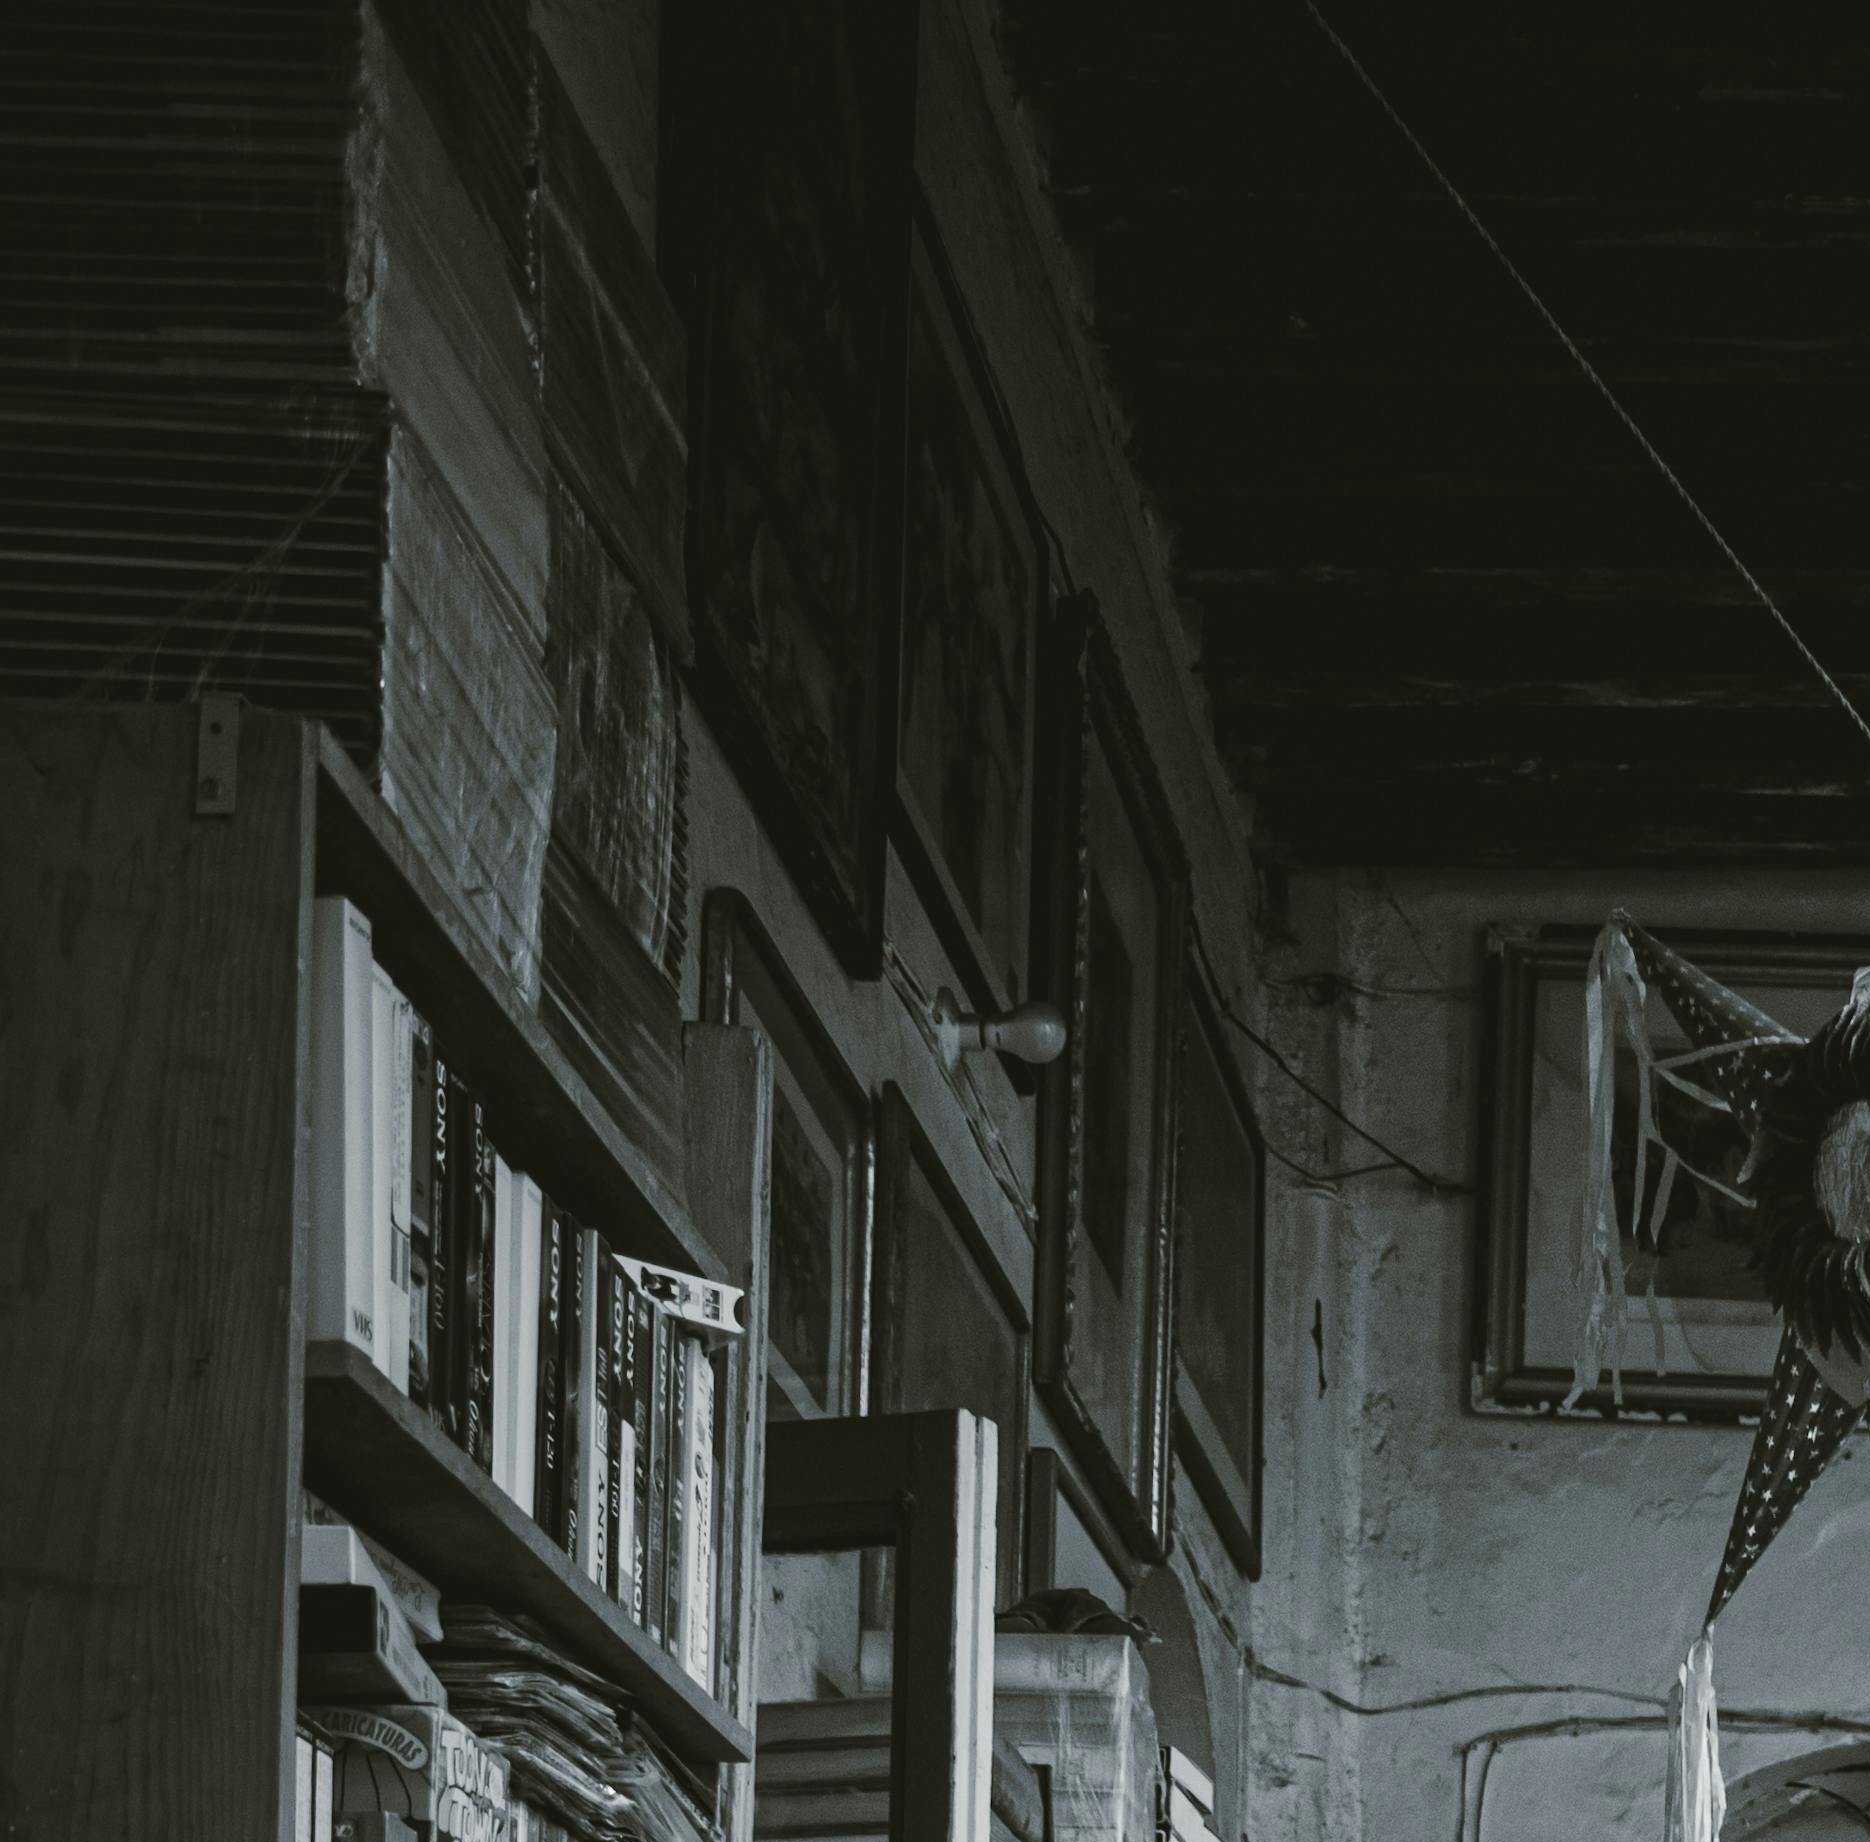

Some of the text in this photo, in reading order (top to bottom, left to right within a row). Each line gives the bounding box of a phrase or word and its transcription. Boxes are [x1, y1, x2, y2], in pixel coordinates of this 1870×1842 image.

[434, 1059, 448, 1175] SONY
[473, 1102, 484, 1203] SONY
[549, 1217, 561, 1333] SONY
[574, 1232, 585, 1322] SONY
[352, 1308, 374, 1343] VHS
[612, 1273, 625, 1385] SONY
[626, 1290, 637, 1389] SONY
[657, 1323, 669, 1418] SONY
[676, 1340, 687, 1435] SONY
[595, 1475, 608, 1592] SONY
[609, 1460, 621, 1518] T-160
[322, 1711, 423, 1763] CARICATURAS
